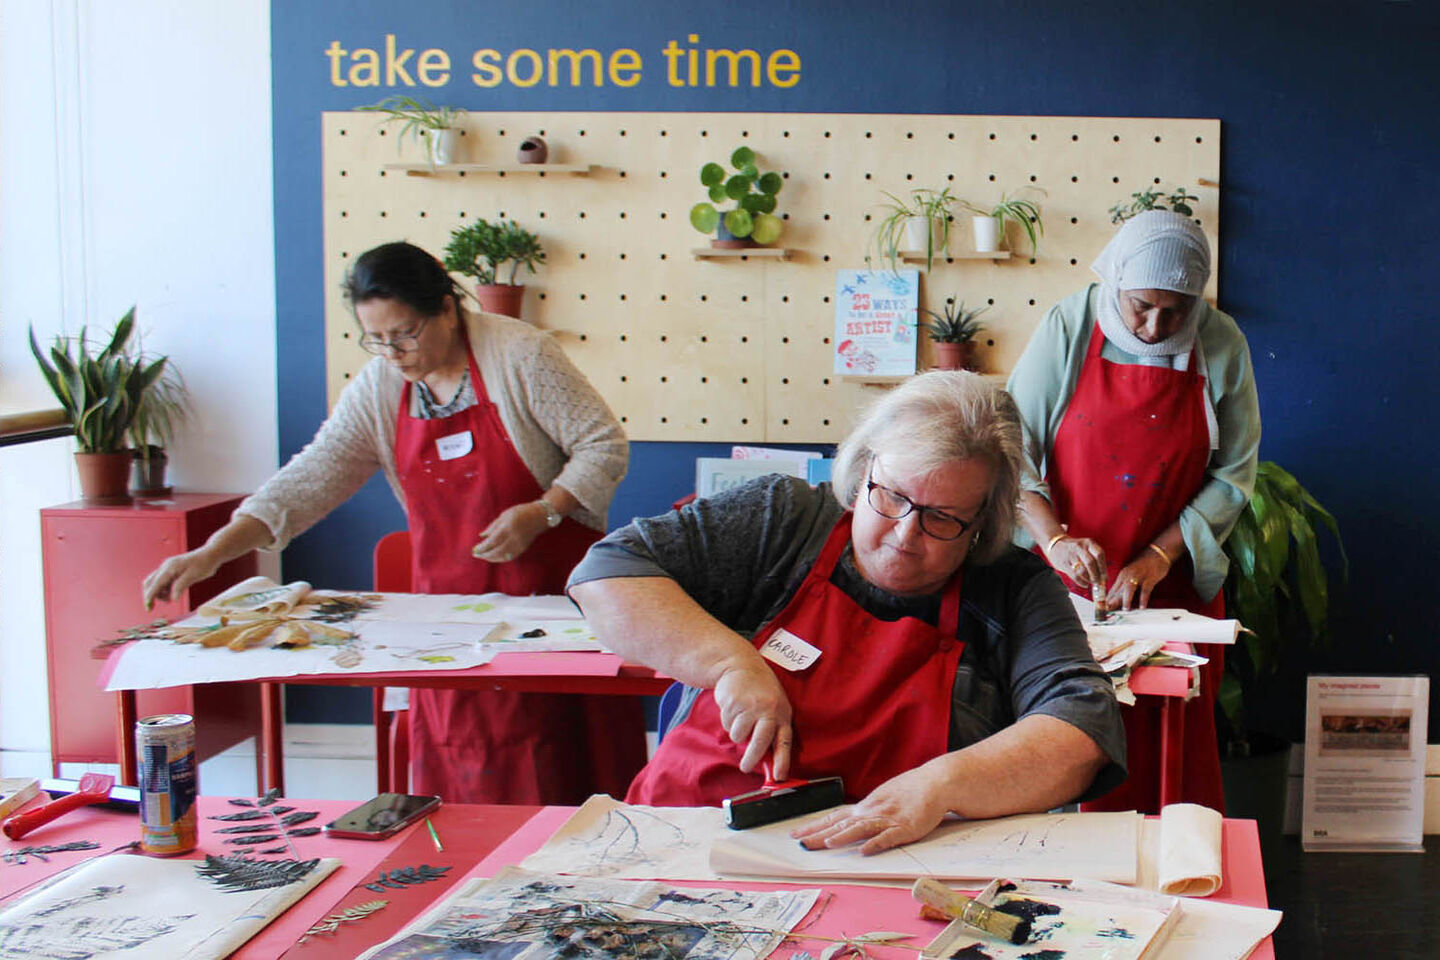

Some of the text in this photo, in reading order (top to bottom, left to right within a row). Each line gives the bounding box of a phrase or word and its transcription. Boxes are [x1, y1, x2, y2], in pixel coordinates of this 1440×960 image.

[325, 34, 801, 87] take some time
[768, 639, 808, 665] CAROLE
